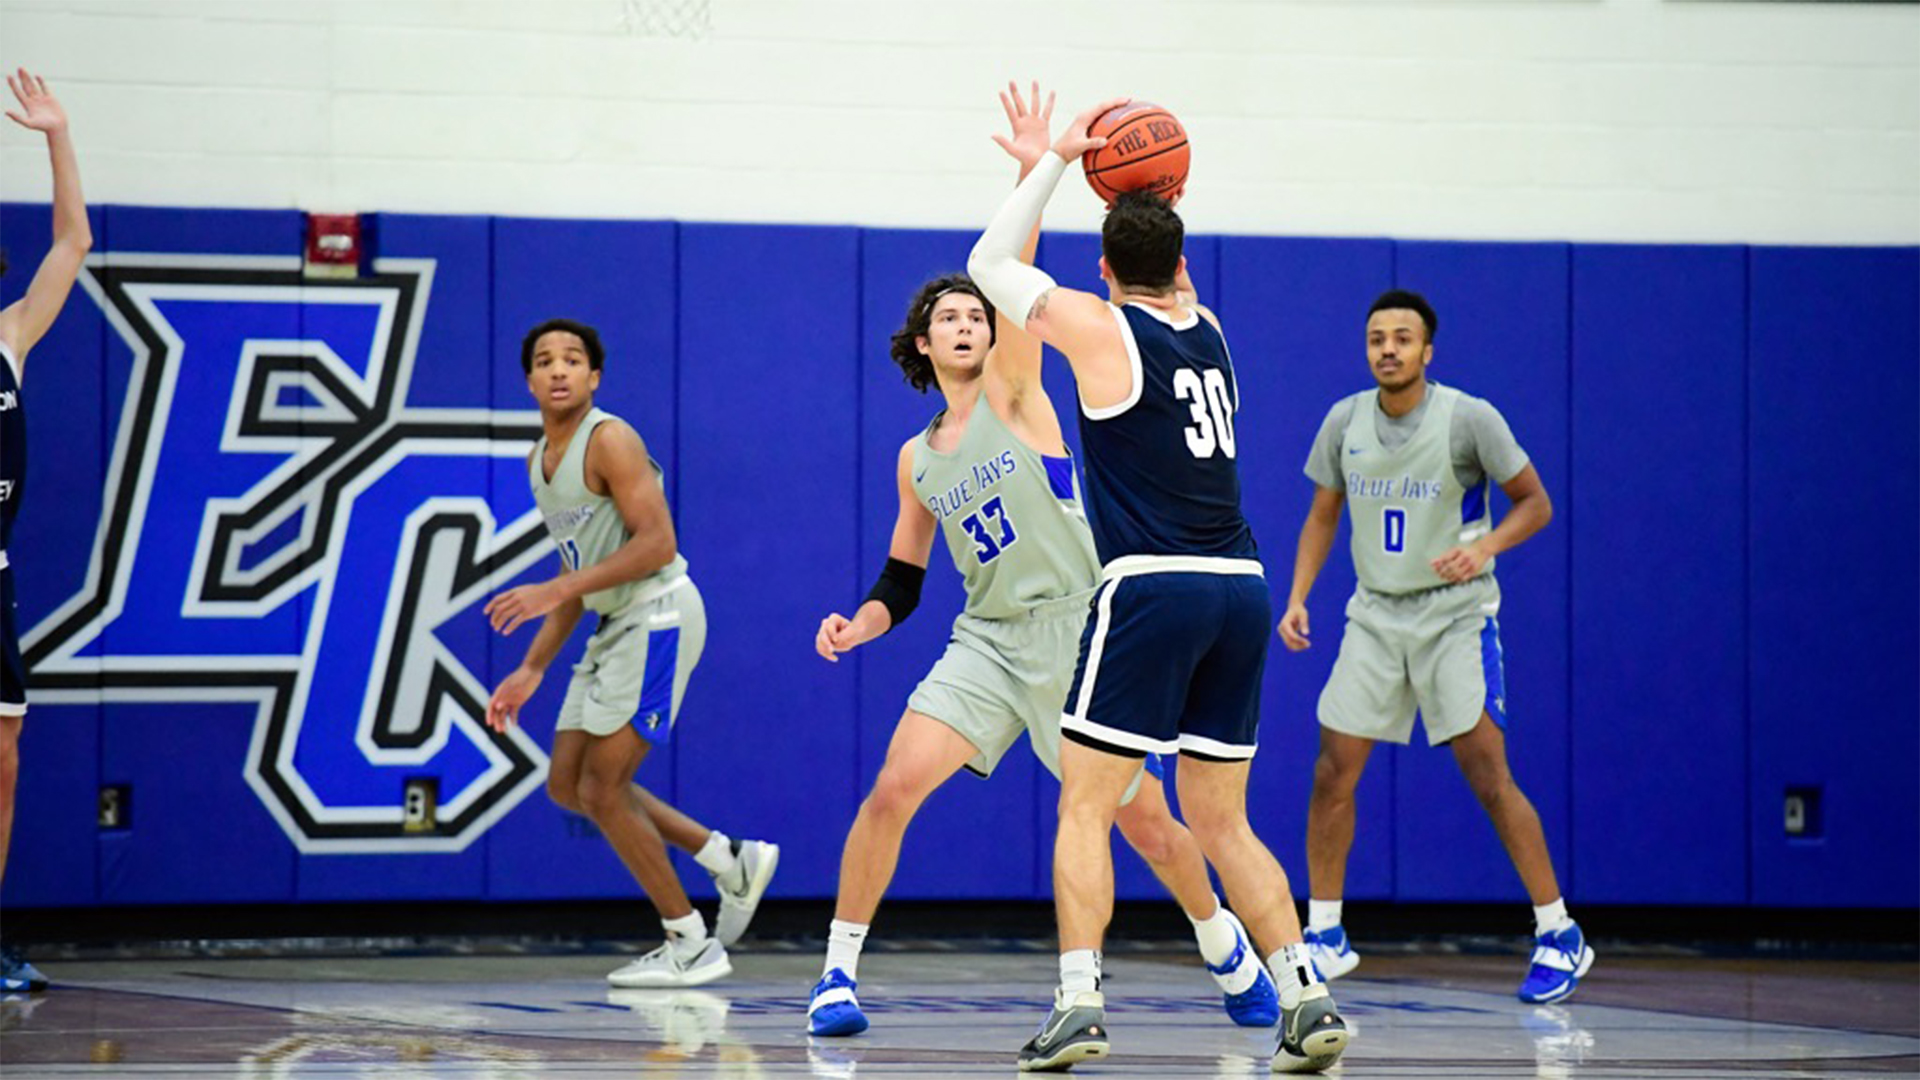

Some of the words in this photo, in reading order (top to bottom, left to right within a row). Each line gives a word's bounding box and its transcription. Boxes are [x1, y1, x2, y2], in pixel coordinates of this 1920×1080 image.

[1112, 127, 1148, 156] THE
[1172, 367, 1236, 460] 30
[927, 477, 973, 522] BLUE
[971, 450, 1017, 494] JAYS
[1349, 472, 1396, 499] BLUE
[1401, 474, 1442, 500] JAYS
[959, 494, 1019, 565] 33
[1382, 506, 1407, 555] 0
